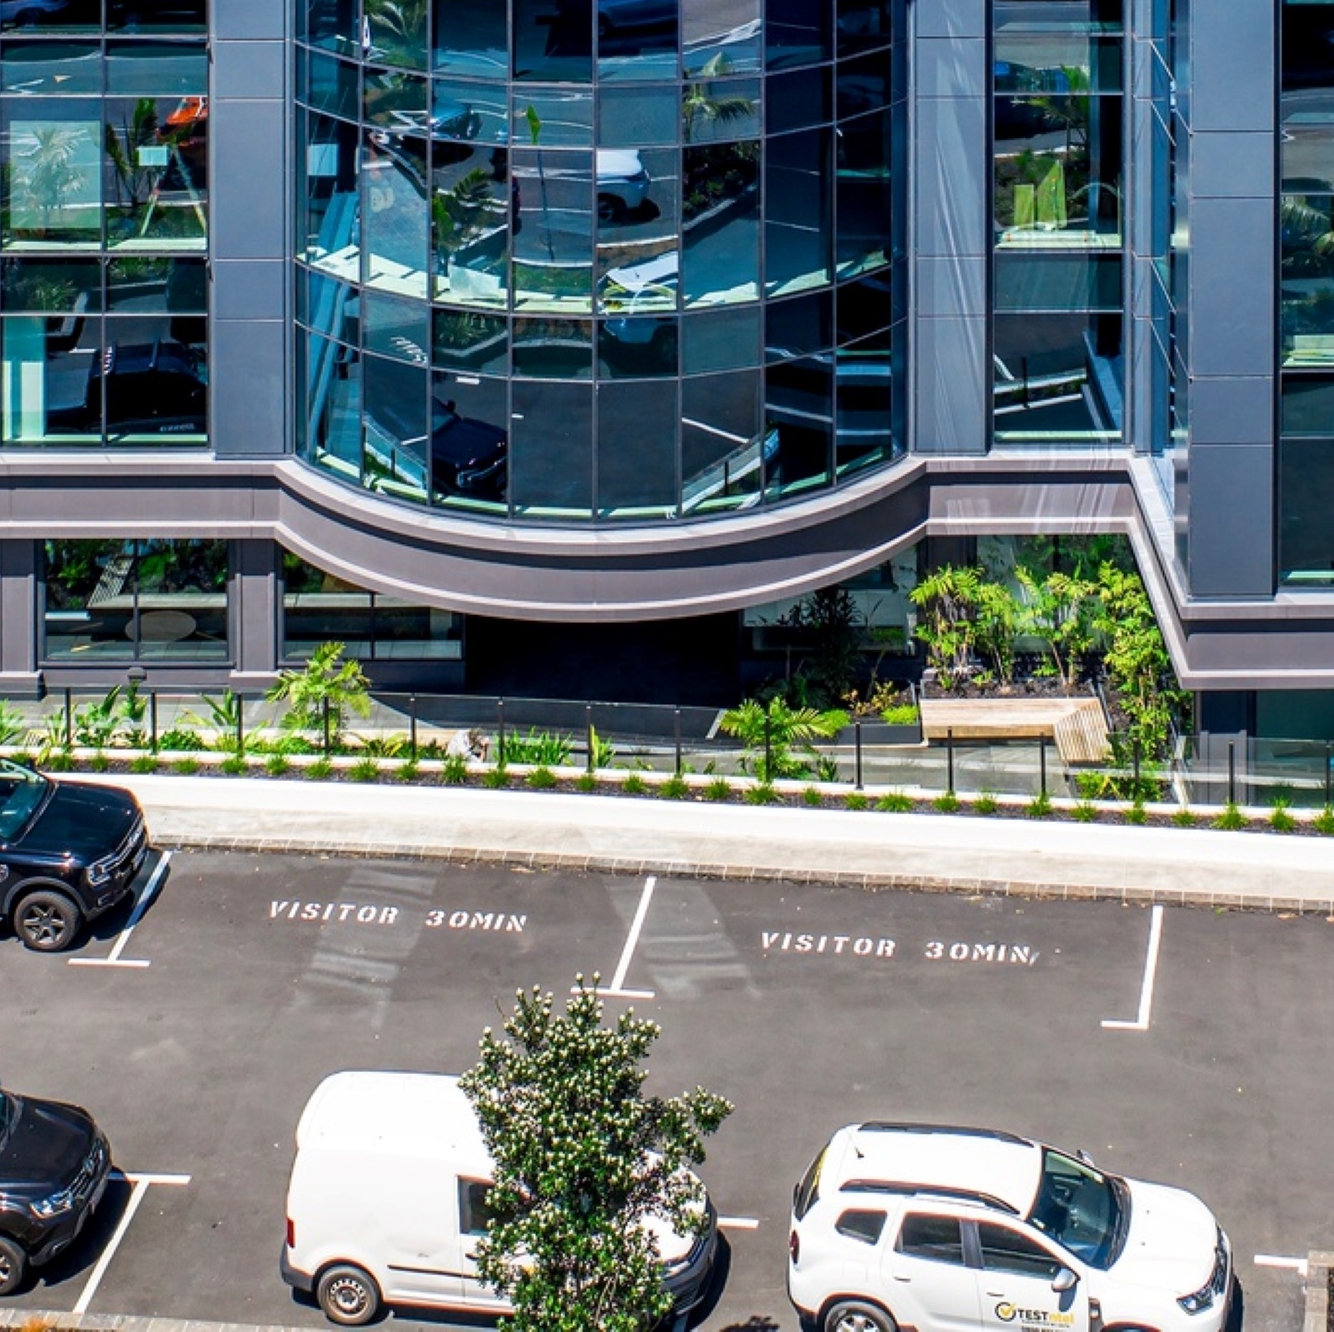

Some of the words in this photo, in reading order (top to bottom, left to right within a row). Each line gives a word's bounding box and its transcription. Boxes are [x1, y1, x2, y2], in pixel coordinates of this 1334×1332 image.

[269, 901, 399, 924] VISITOR
[425, 910, 526, 932] 30MIN
[761, 932, 896, 957] VISITOR
[924, 941, 1031, 963] 30MIN
